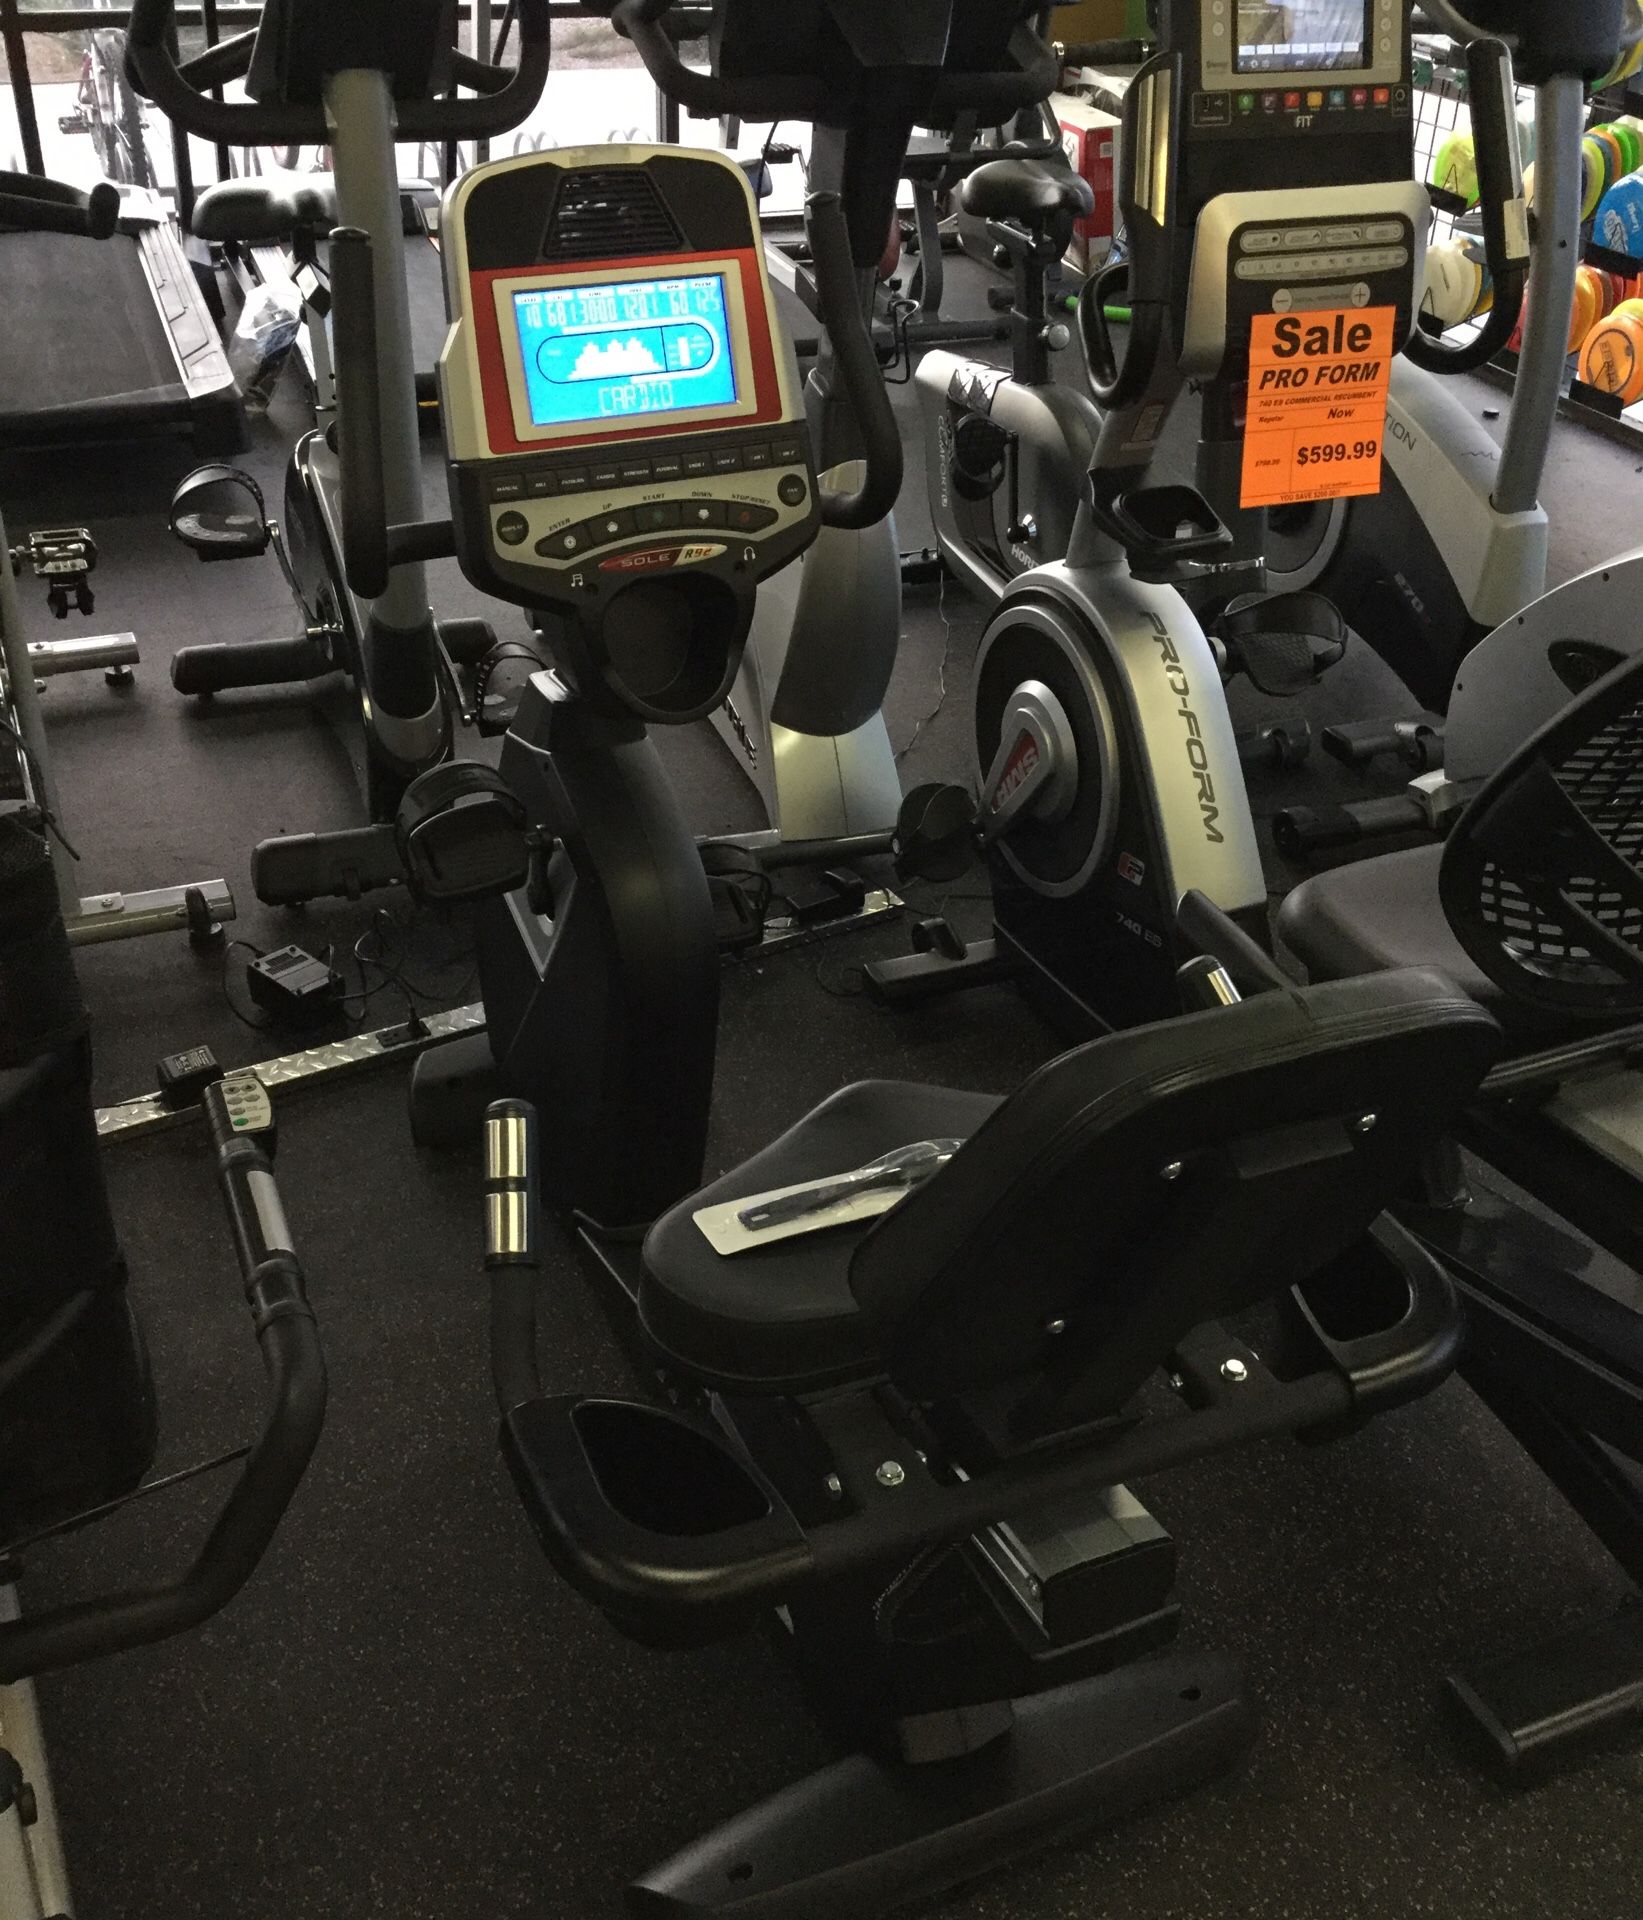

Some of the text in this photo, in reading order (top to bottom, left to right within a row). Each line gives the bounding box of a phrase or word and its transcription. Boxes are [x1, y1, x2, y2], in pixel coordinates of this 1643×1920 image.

[1272, 315, 1372, 358] Sale
[1259, 362, 1381, 390] PRO FORM
[599, 382, 673, 414] CARDIO
[1285, 394, 1331, 405] COMMERCIAL
[1333, 390, 1378, 400] RECUMBENT
[1259, 408, 1355, 424] Regular Now
[1297, 440, 1377, 467] $599.99
[643, 493, 665, 501] START
[1280, 494, 1294, 502] YOU
[1295, 492, 1312, 500] SAVE
[549, 518, 570, 531] ENTER
[620, 547, 713, 567] SOLE R92
[1140, 611, 1224, 843] PRO-FORM
[1115, 912, 1142, 936] 740
